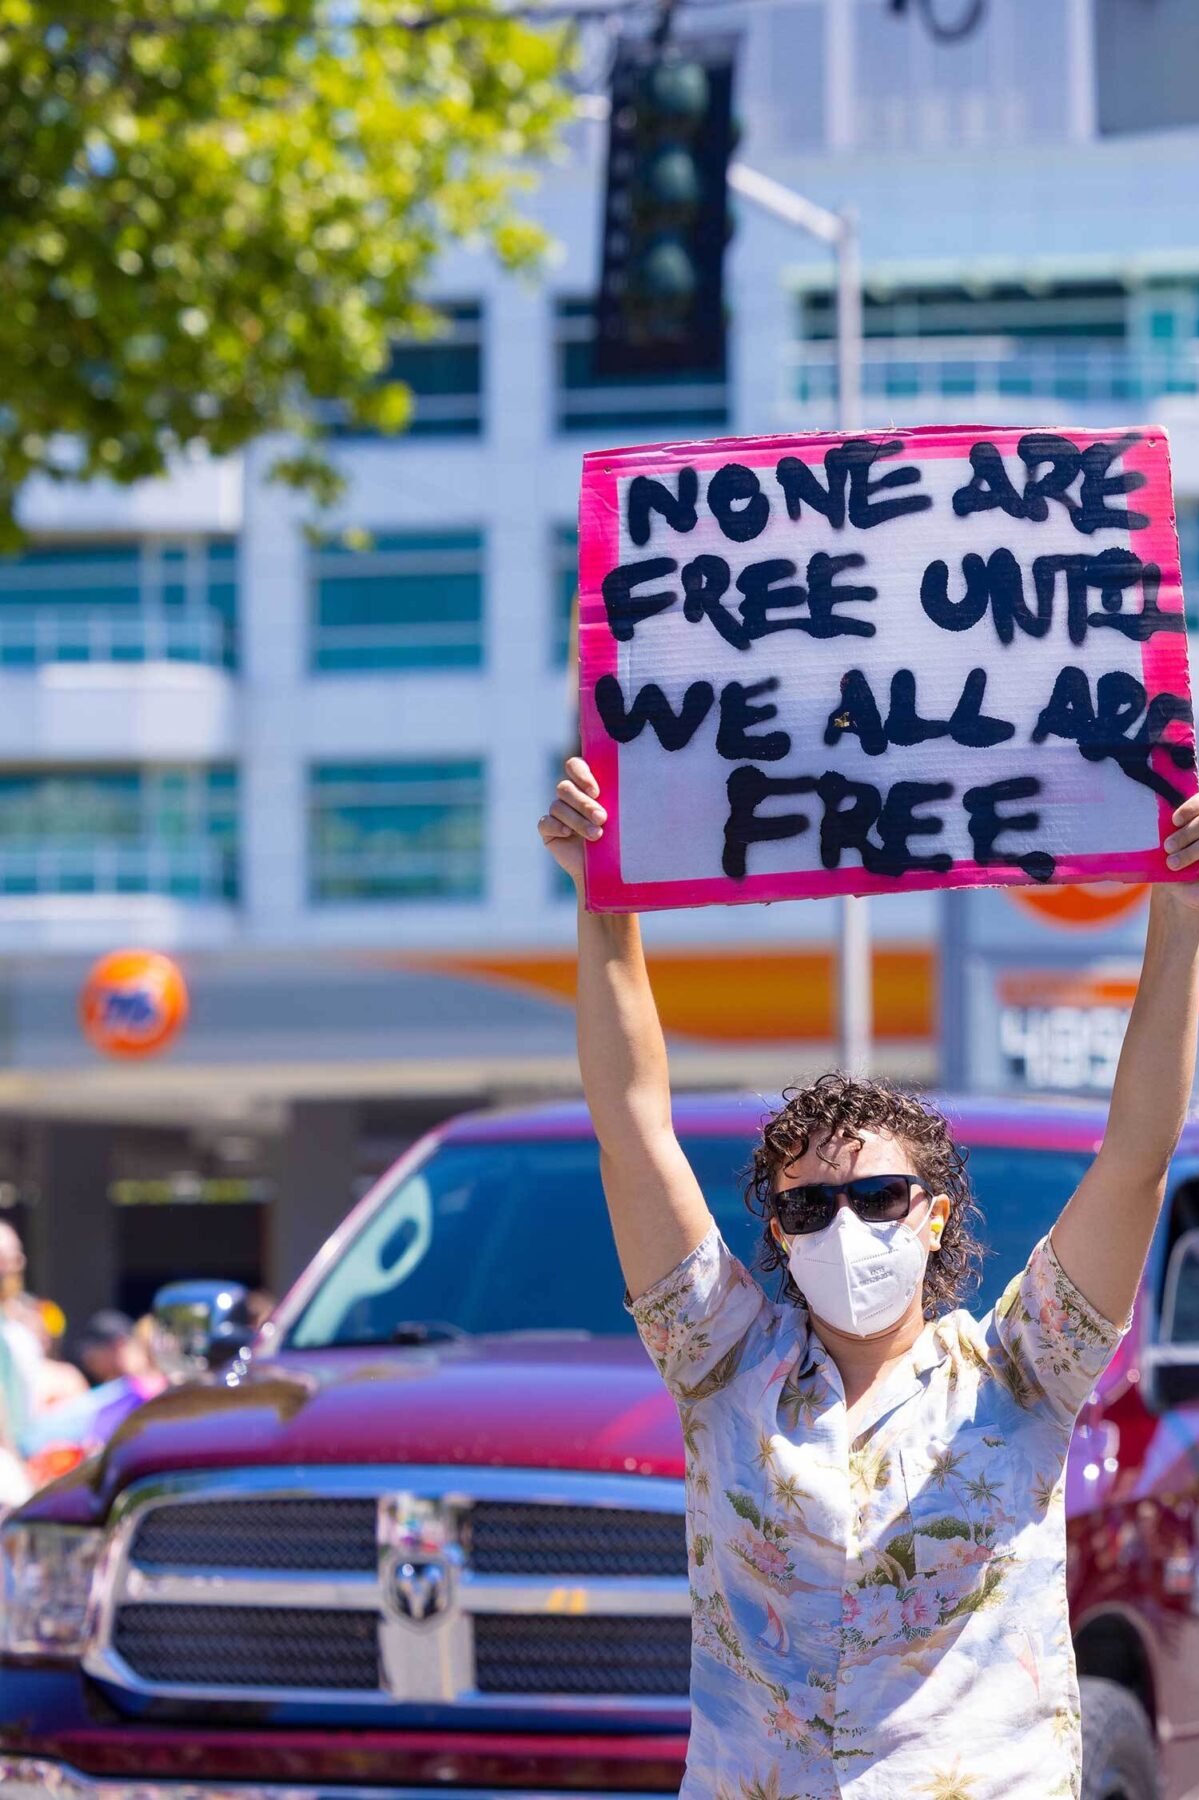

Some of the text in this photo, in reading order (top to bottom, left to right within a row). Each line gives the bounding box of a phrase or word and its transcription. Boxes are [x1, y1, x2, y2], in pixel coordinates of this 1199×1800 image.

[627, 432, 1150, 546] NONE ARE
[601, 546, 1185, 651] FREE UNTIL
[594, 665, 1197, 808] WE ALL ARE
[720, 765, 1057, 883] FREE
